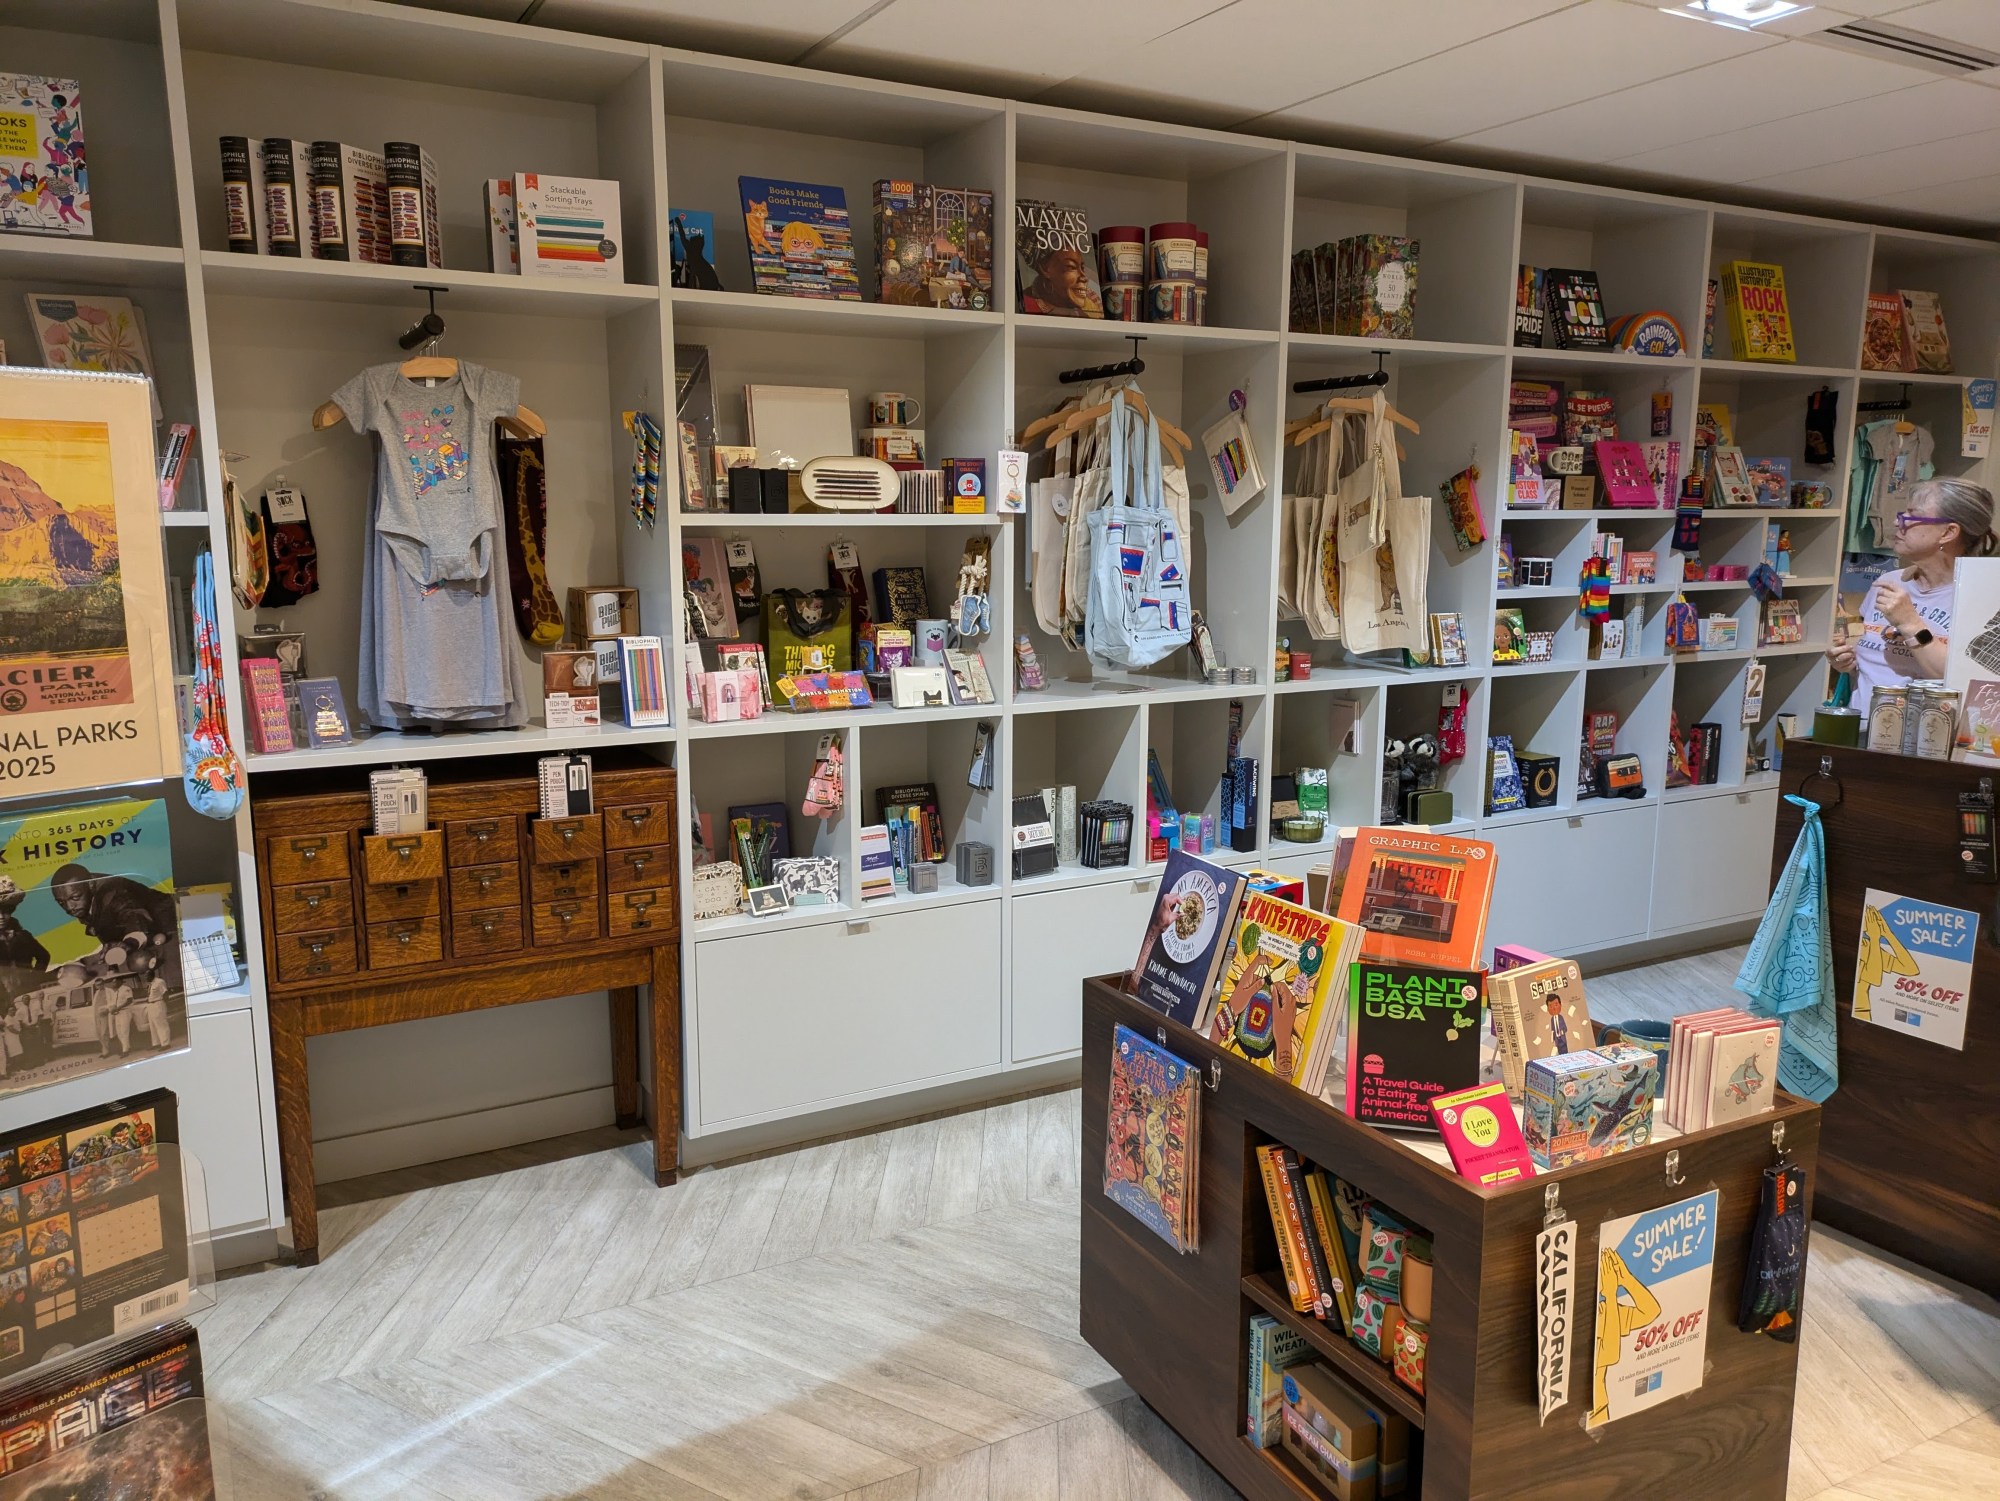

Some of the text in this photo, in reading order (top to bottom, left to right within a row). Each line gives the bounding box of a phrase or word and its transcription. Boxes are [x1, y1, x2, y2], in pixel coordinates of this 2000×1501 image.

[386, 157, 419, 166] BIBLIOPHILE
[550, 186, 586, 196] Stackable
[769, 186, 820, 199] Books Make
[891, 183, 912, 192] 1000
[544, 194, 593, 206] Sorting Trays
[768, 196, 824, 208] Good Friends
[1016, 206, 1088, 232] MAYA'S
[690, 226, 704, 235] Cat
[1035, 228, 1092, 254] SONG
[1738, 266, 1776, 279] ILLUSTRATED
[1740, 275, 1772, 288] HISTORY OF
[1558, 283, 1600, 300] BLACK
[1740, 285, 1786, 313] ROCK
[1516, 306, 1544, 318] HOLLYWOOD
[1564, 301, 1604, 326] JOY
[1516, 317, 1542, 334] PRIDE
[1567, 325, 1606, 338] PROJECT
[1638, 324, 1676, 347] RAINBOW
[1650, 341, 1664, 354] GO!
[1971, 384, 1994, 396] SUMMER
[1577, 401, 1612, 413] SE PUEDE
[1517, 489, 1538, 500] CLASS
[1845, 566, 1887, 574] something
[40, 680, 109, 692] PARK
[824, 687, 863, 695] DOMINATION
[41, 691, 86, 700] NATIONAL
[50, 695, 108, 704] SERVICE
[1594, 715, 1615, 728] RAP
[57, 720, 137, 746] PARKS
[0, 755, 55, 780] 2025
[8, 815, 138, 841] INTO 365 DAYS OF
[24, 829, 142, 860] HISTORY
[1369, 836, 1441, 851] GRAPHIC
[1177, 875, 1217, 915] MY AMERICA
[1246, 896, 1330, 946] KNITSTRIPS
[1894, 909, 1967, 930] SUMMER
[1912, 928, 1966, 948] SALE!
[1148, 959, 1197, 995] KWAME ONWUACHI
[1366, 972, 1468, 992] PLANT
[1530, 976, 1568, 999] Salazar
[1894, 976, 1964, 1005] 50% OFF
[1366, 988, 1468, 1008] BASED
[1927, 1000, 1944, 1008] SELECT
[1944, 1004, 1960, 1012] ITEMS
[1365, 1003, 1426, 1022] USA
[14, 1057, 93, 1084] 2025 CALENDAR
[1134, 1051, 1164, 1079] PAPER
[1130, 1062, 1166, 1092] CHAINS
[1530, 1070, 1539, 1080] 20
[1362, 1077, 1444, 1092] A Travel Guide
[1529, 1080, 1551, 1093] PUZZLE
[1362, 1086, 1418, 1102] to Eating
[1362, 1097, 1428, 1112] Animal-free
[1361, 1107, 1428, 1122] in America
[1465, 1117, 1492, 1130] I Love
[1474, 1128, 1491, 1137] You
[1552, 1133, 1586, 1147] 20 PUZZLE
[1265, 1169, 1294, 1277] HUNGRY CAMPERS
[1276, 1155, 1318, 1298] ONE WOK ONE POT
[1632, 1203, 1707, 1258] SUMMER
[1314, 1206, 1334, 1267] LUNCH TO GO
[1651, 1227, 1705, 1274] SALE!
[1550, 1230, 1568, 1406] CALIFORNIA
[1634, 1310, 1703, 1351] 50% OFF
[1636, 1352, 1646, 1361] AND
[1647, 1347, 1661, 1357] MORE
[1669, 1337, 1686, 1348] SELECT
[1686, 1332, 1700, 1342] ITEMS
[1652, 1360, 1668, 1370] reduced
[1, 1344, 187, 1426] THE HUBBLE AND JAMES WEBB TELESCOPES
[0, 1354, 192, 1473] PACE
[1287, 1413, 1340, 1470] ICE CREAM CHALK
